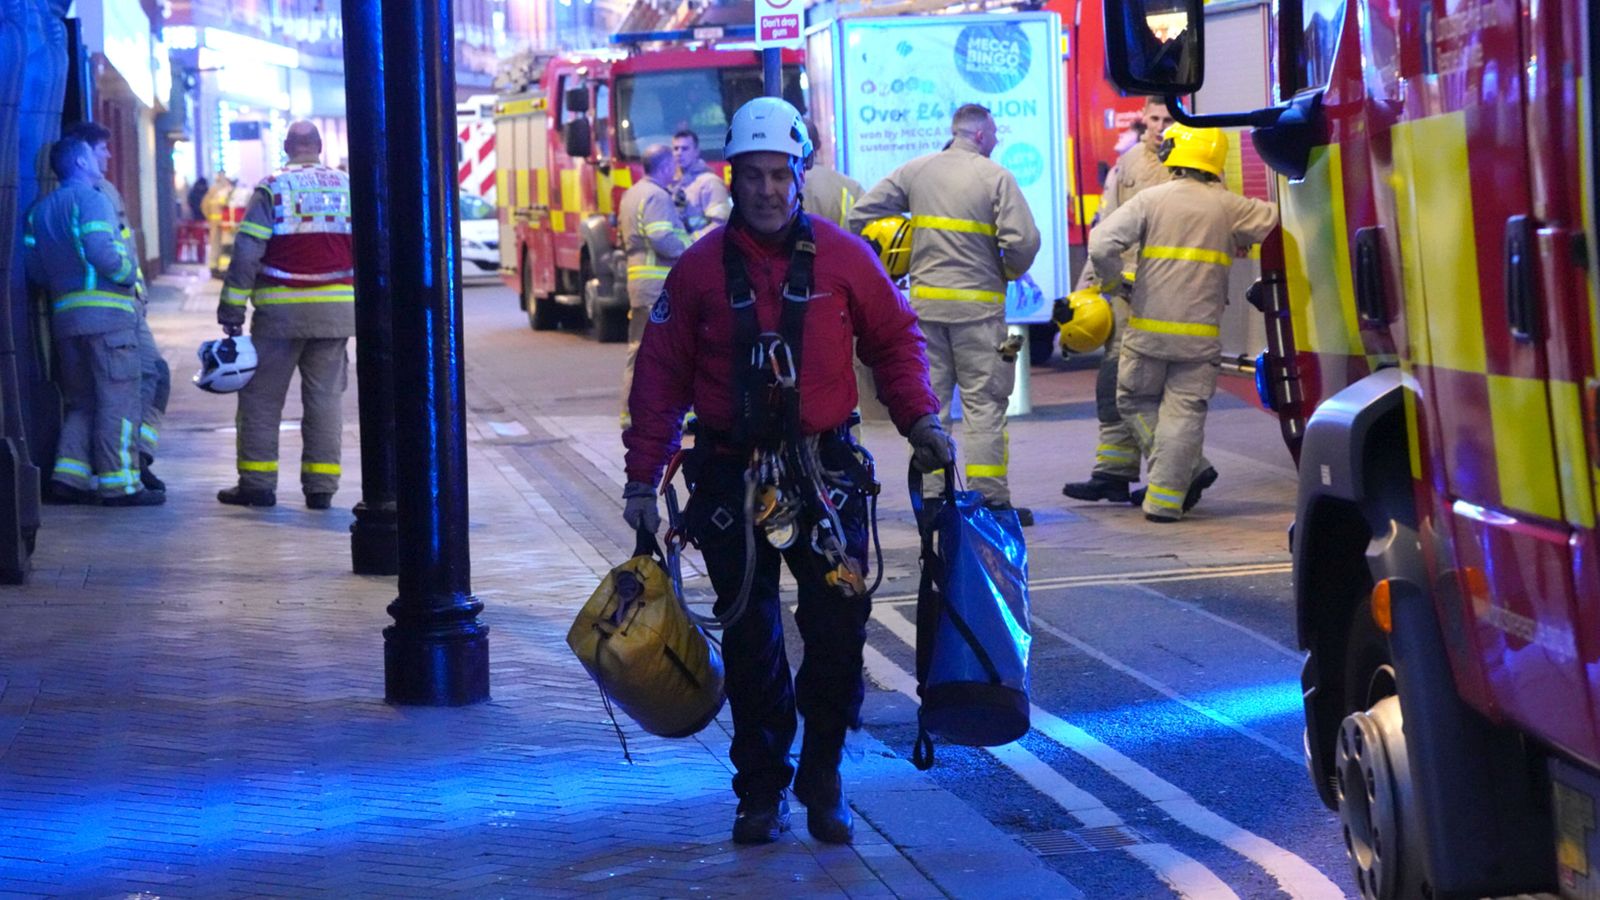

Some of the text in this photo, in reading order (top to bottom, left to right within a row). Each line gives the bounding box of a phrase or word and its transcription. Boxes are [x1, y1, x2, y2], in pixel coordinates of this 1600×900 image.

[762, 17, 797, 28] Don't drop
[772, 28, 788, 39] gum
[967, 37, 1020, 54] MECCA
[966, 49, 1020, 69] BINGO
[859, 104, 911, 123] Over
[917, 102, 945, 119] £4
[860, 131, 882, 139] won
[884, 130, 898, 140] by
[901, 127, 942, 138] MECCA
[860, 142, 917, 152] customers
[918, 141, 930, 149] in
